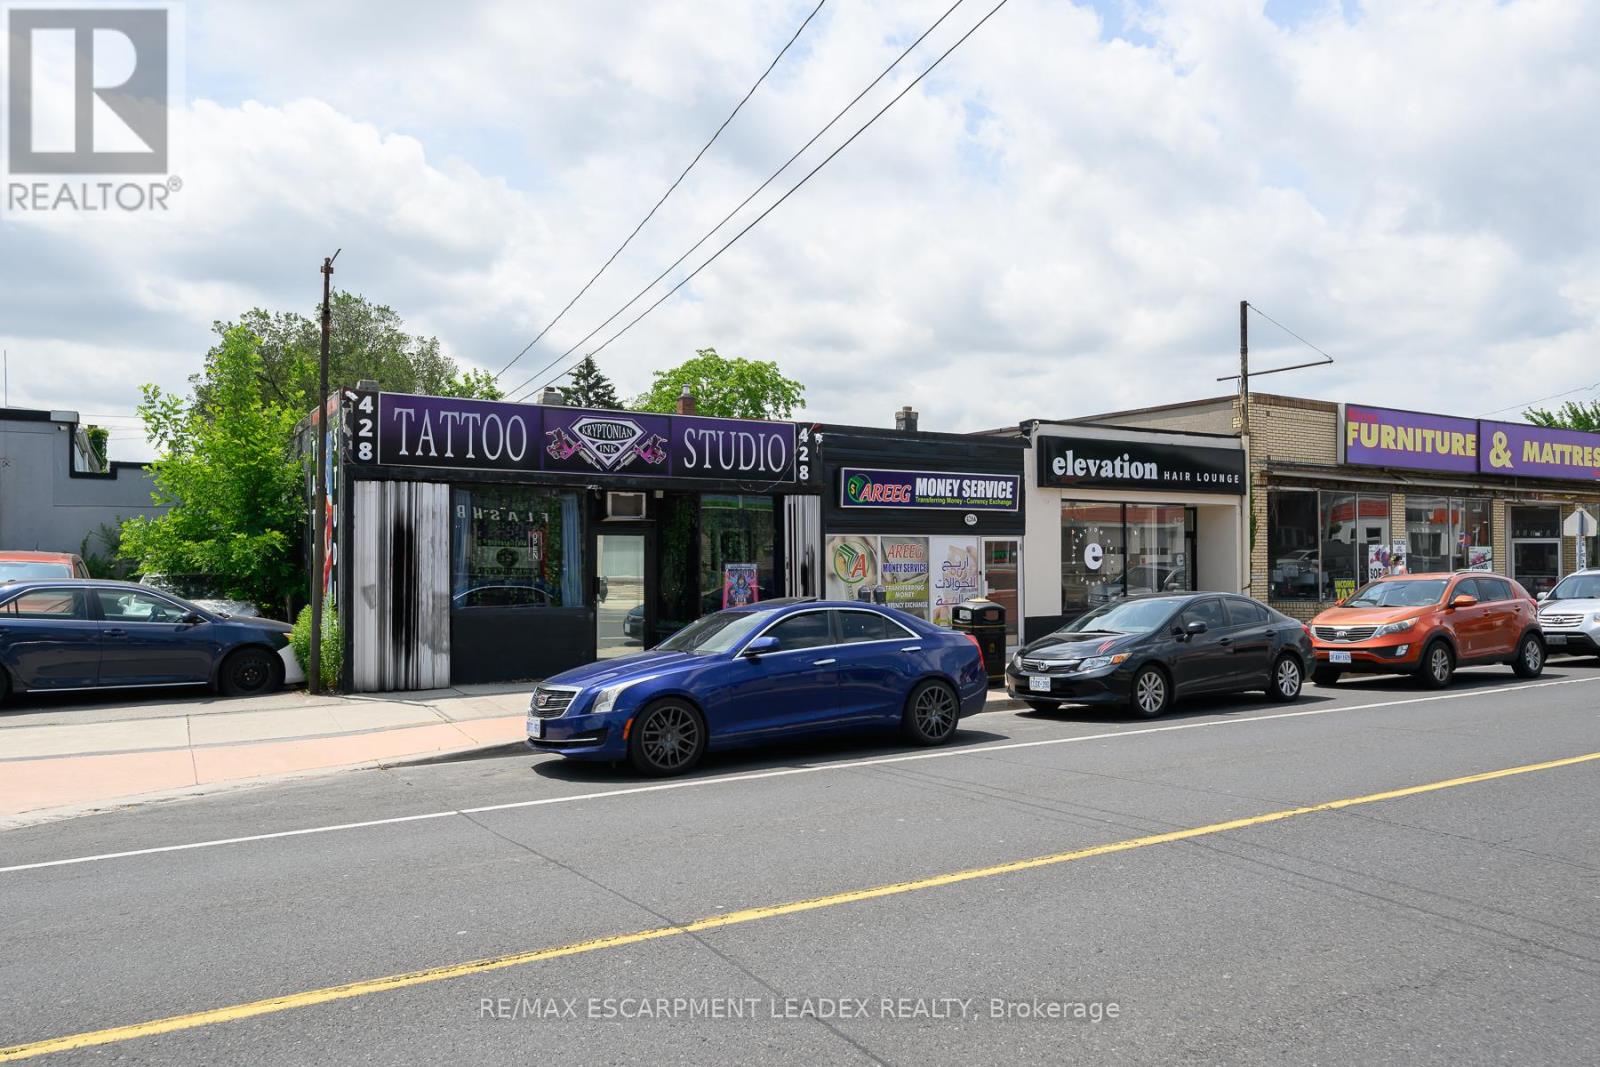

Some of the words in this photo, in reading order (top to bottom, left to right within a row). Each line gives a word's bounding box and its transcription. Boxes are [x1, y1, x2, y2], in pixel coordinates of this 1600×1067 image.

[393, 407, 527, 462] TATTOO
[582, 423, 633, 439] KRYPTONIAN
[600, 444, 617, 453] INK
[683, 427, 786, 473] STUDIO
[1347, 421, 1477, 457] FURNITURE
[1489, 431, 1514, 469] &
[1052, 450, 1158, 480] elevation
[1163, 471, 1190, 481] HAIR
[1196, 472, 1240, 483] LOUNGE
[859, 483, 912, 503] AREEG
[915, 477, 960, 497] MONEY
[962, 479, 1013, 499] SERVICE
[915, 496, 945, 504] Transferring
[946, 497, 962, 505] Money
[966, 498, 988, 506] Currency
[989, 498, 1012, 506] Exchange
[888, 543, 924, 560] AREEG
[882, 562, 903, 573] MONEY
[903, 562, 928, 573] SERVICE
